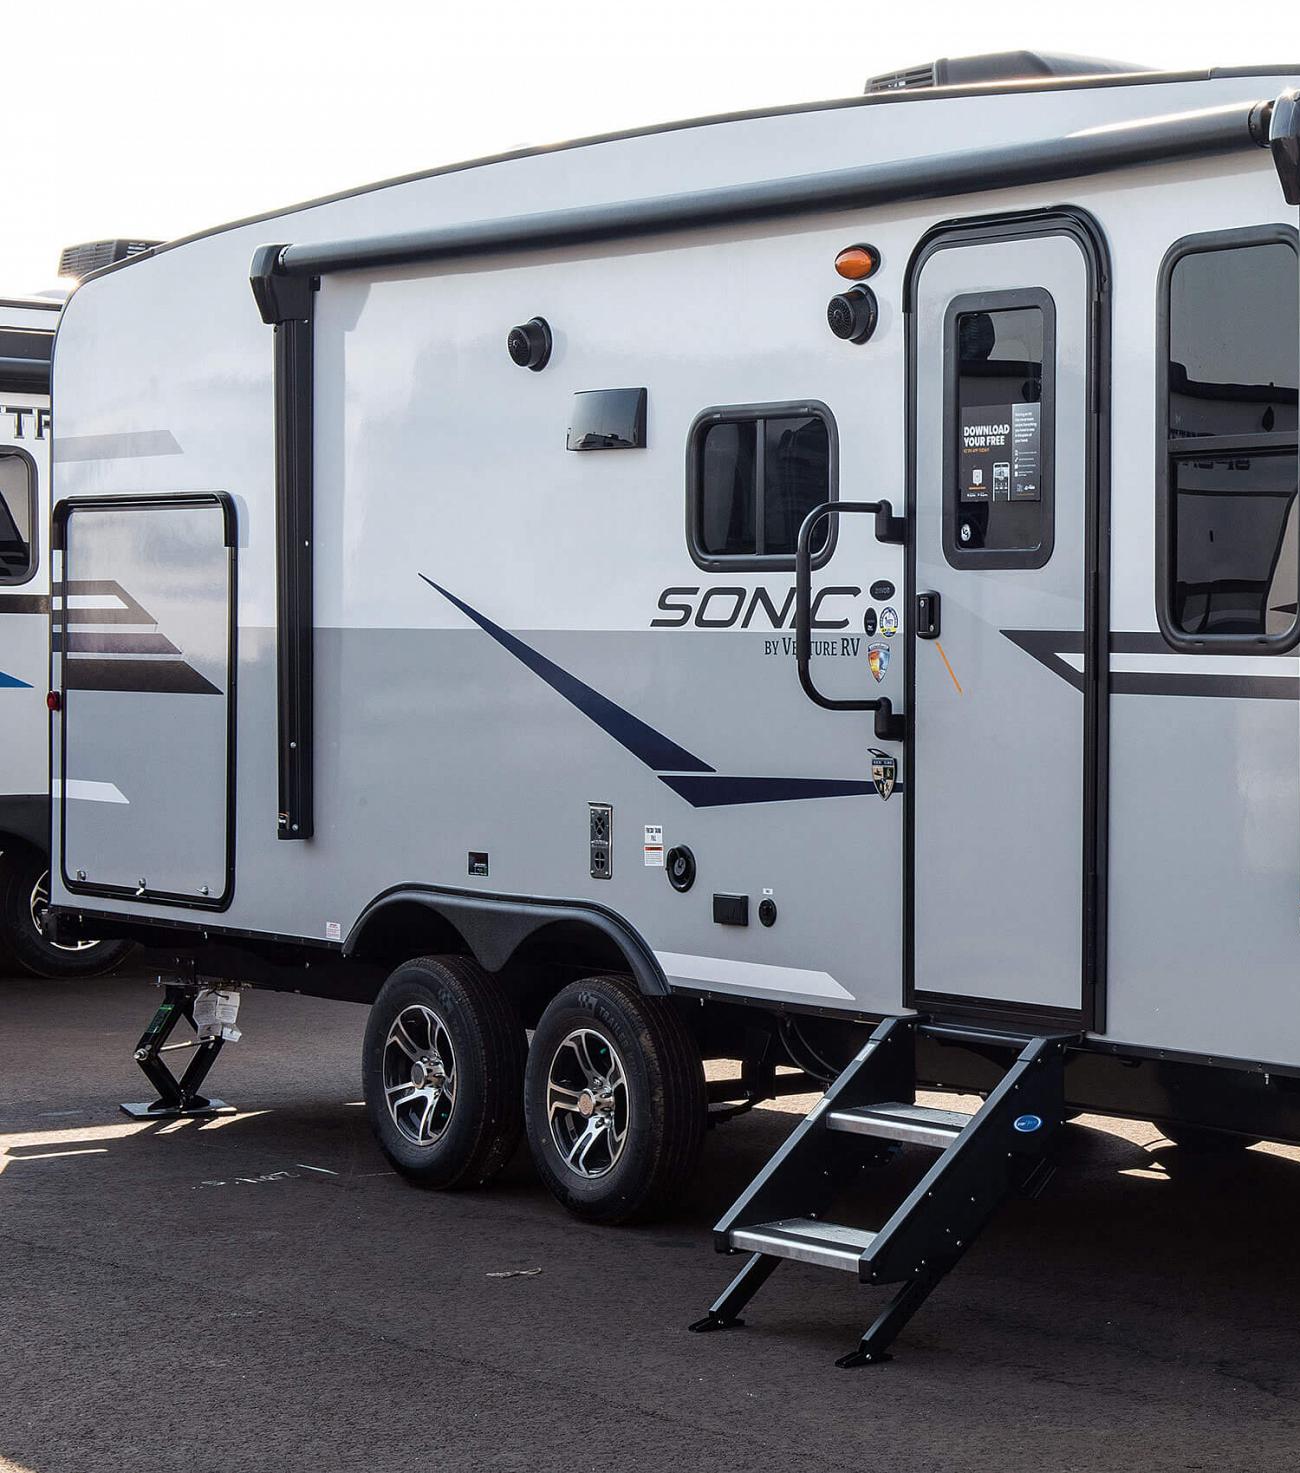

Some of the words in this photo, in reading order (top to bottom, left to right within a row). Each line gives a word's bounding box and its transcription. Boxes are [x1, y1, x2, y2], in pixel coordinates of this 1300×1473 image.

[963, 424, 1010, 436] DOWNLOAD
[963, 437, 986, 447] YOUR
[986, 435, 1005, 446] FREE
[649, 586, 861, 630] SONC
[764, 640, 779, 656] BY
[840, 637, 861, 657] RV
